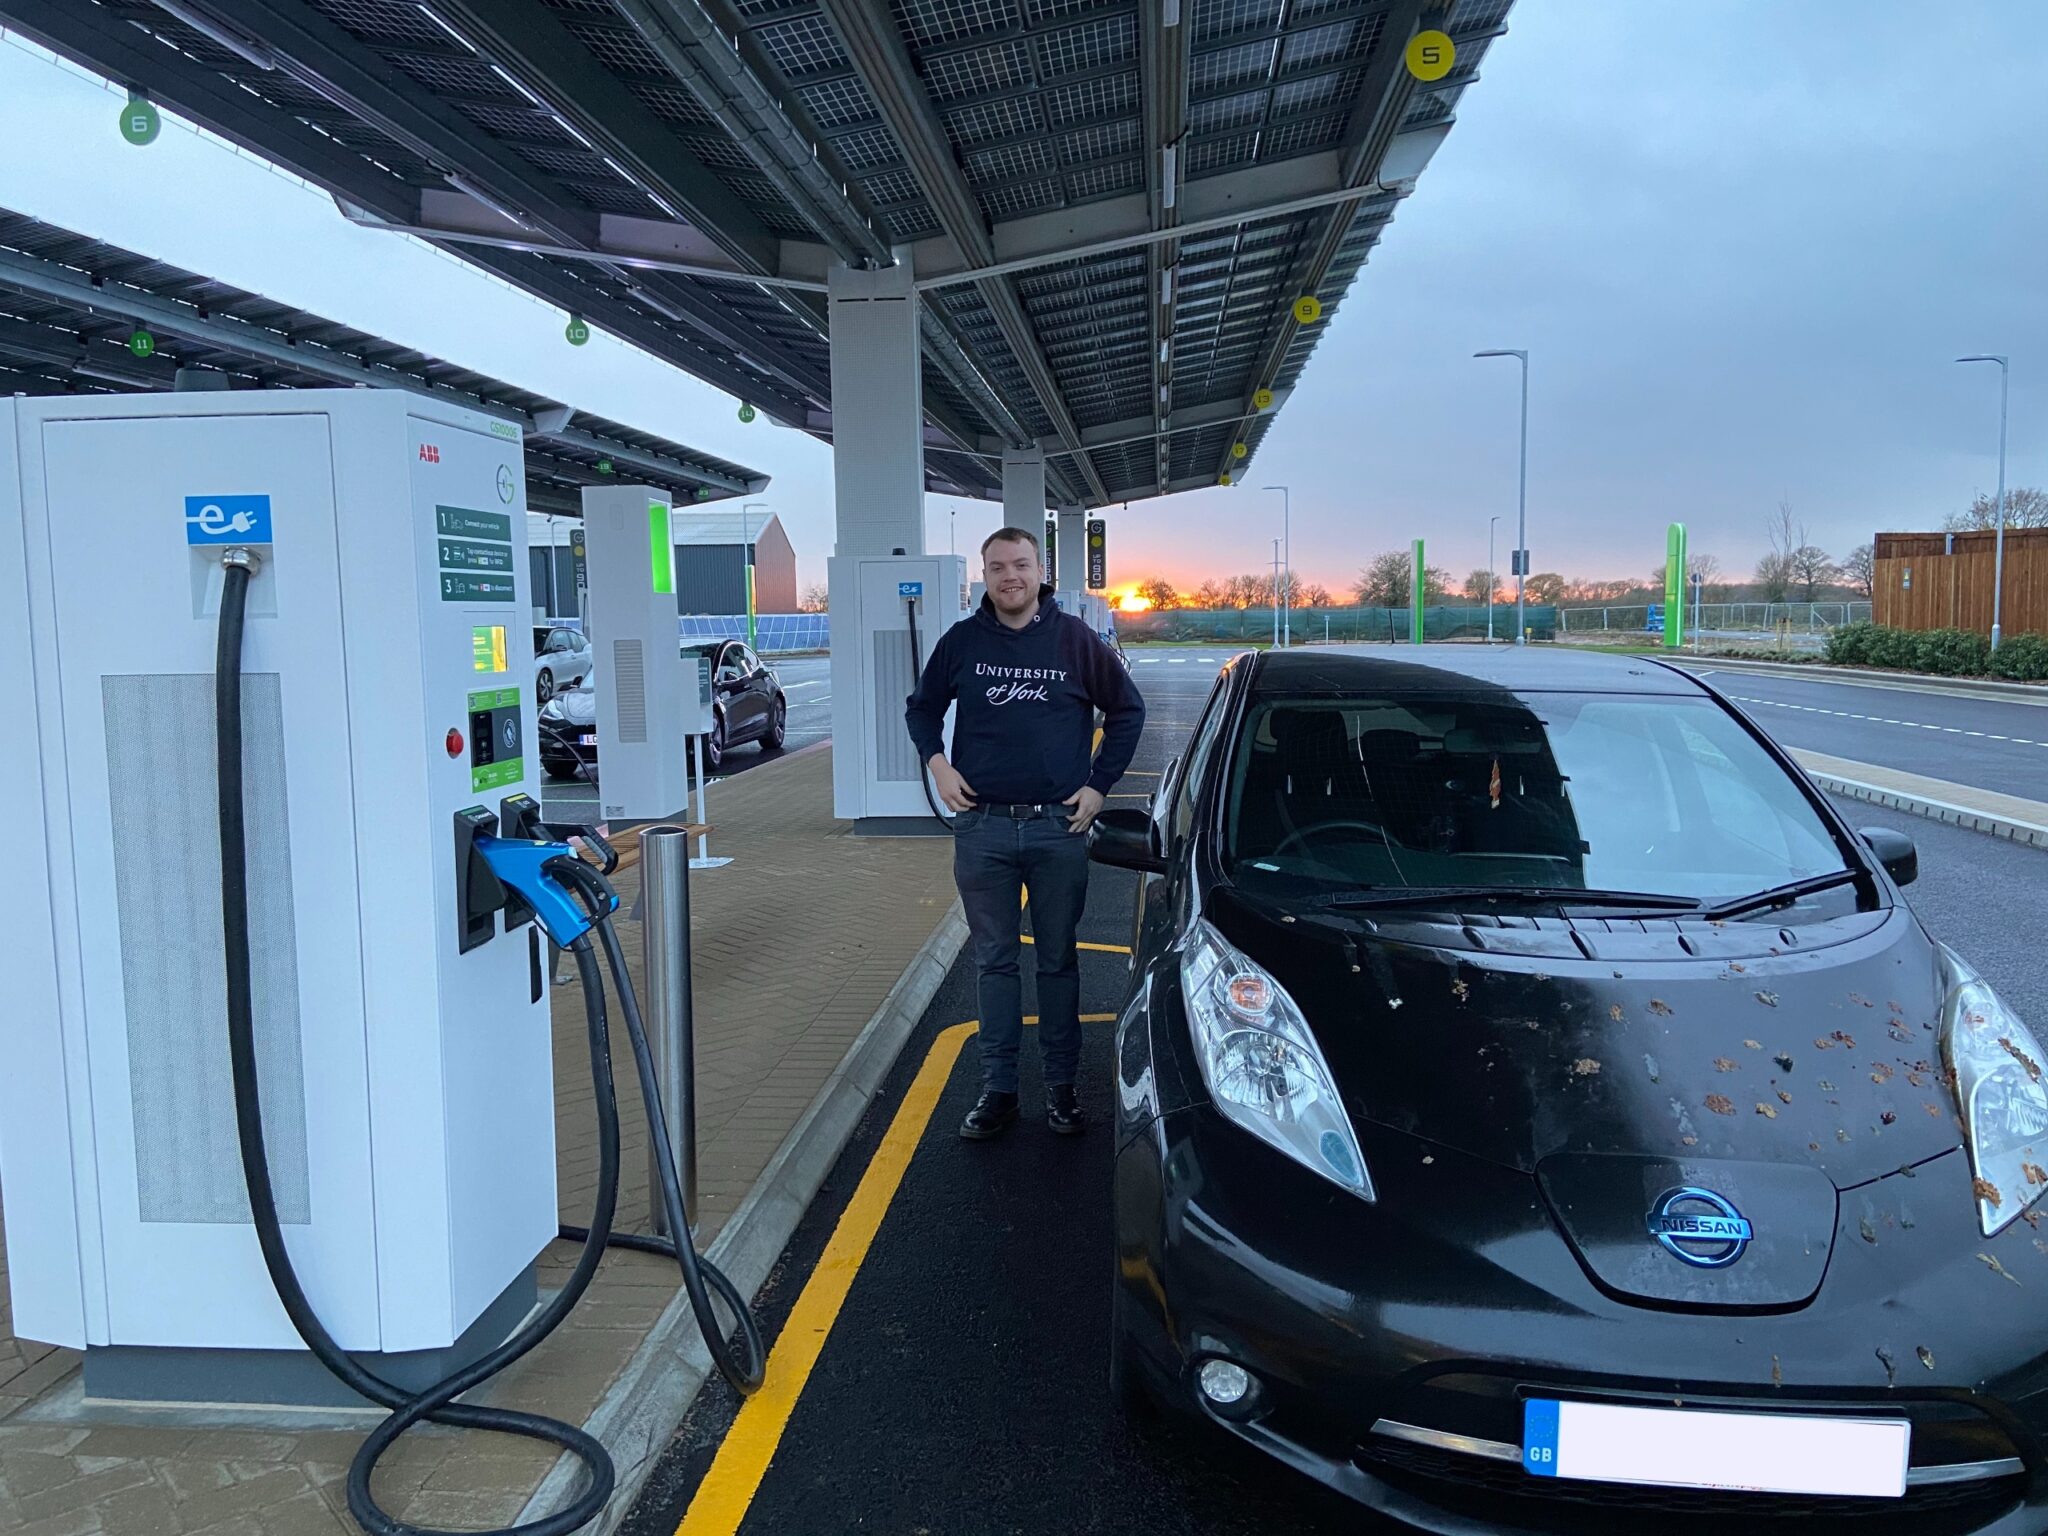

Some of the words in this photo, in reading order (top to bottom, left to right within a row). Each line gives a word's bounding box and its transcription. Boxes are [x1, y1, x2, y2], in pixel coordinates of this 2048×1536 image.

[1422, 46, 1440, 65] 5
[131, 115, 148, 133] 6
[1302, 305, 1313, 315] 9
[569, 328, 586, 339] 10
[136, 339, 148, 349] 11
[419, 443, 440, 464] ABB
[441, 512, 446, 527] 1
[443, 546, 450, 561] 2
[445, 579, 452, 593] 3
[975, 663, 1067, 682] UNIVERSITY
[985, 683, 1007, 699] of
[988, 681, 1049, 706] York
[1661, 1218, 1743, 1235] NISSAN
[1529, 1446, 1552, 1463] GB
